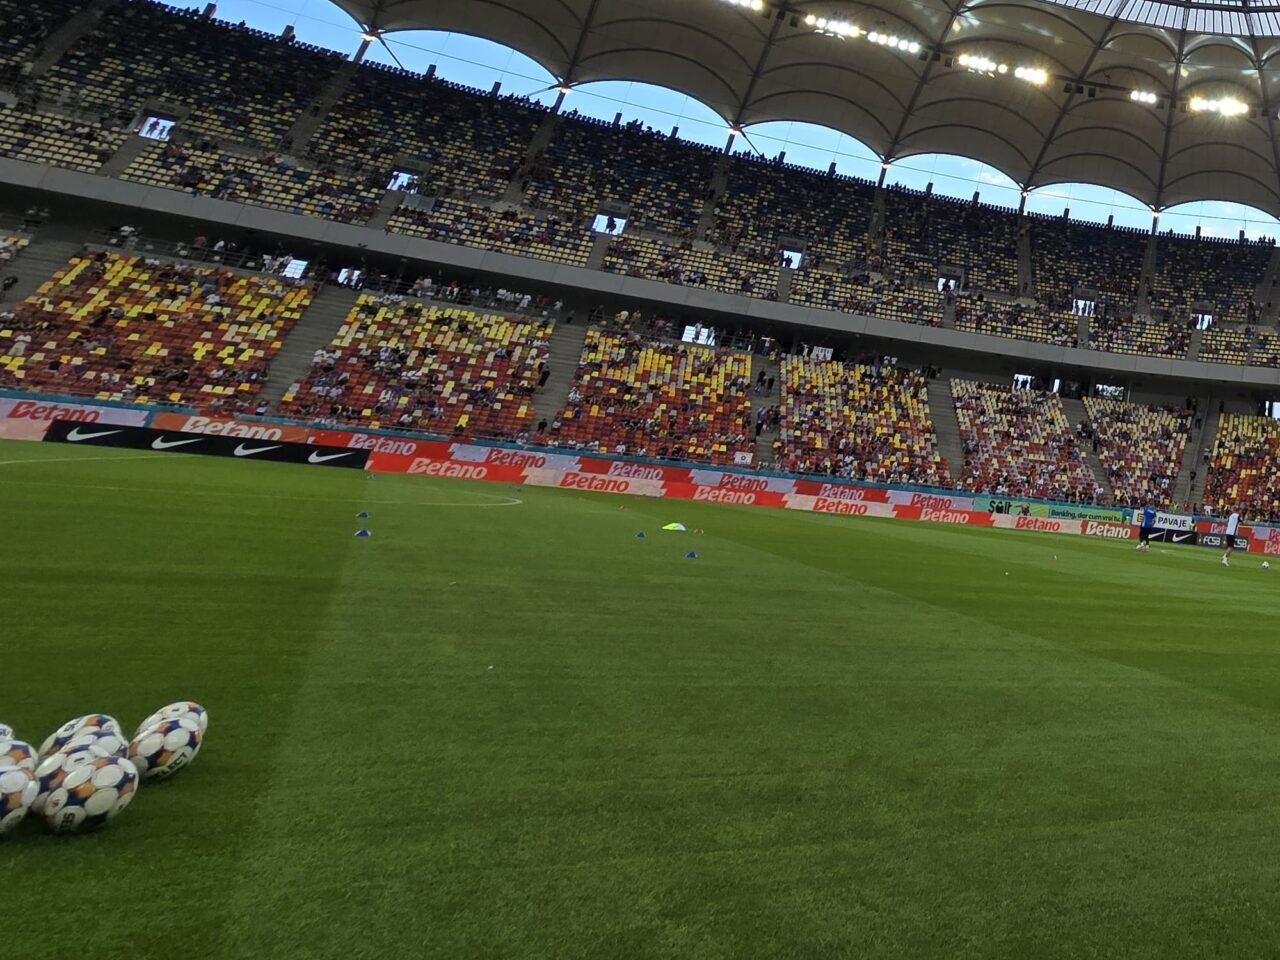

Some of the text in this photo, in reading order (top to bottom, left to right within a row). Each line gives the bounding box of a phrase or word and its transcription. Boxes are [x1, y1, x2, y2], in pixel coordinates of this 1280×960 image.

[7, 401, 101, 422] Betano
[180, 415, 282, 440] Betano
[347, 433, 417, 455] Betano
[485, 448, 546, 468] Betano
[407, 457, 487, 479] Betano
[608, 461, 663, 480] Betano
[560, 472, 629, 492] Betano
[719, 473, 768, 490] Betano
[693, 486, 755, 504] Betano
[819, 483, 865, 500] Betano
[812, 497, 867, 515] Betano
[910, 493, 952, 509] Betano
[919, 508, 969, 524] Betano
[1015, 516, 1060, 532] Betano
[1157, 516, 1187, 527] PAVAJE
[1086, 521, 1131, 539] Betano
[1233, 538, 1248, 548] CSB
